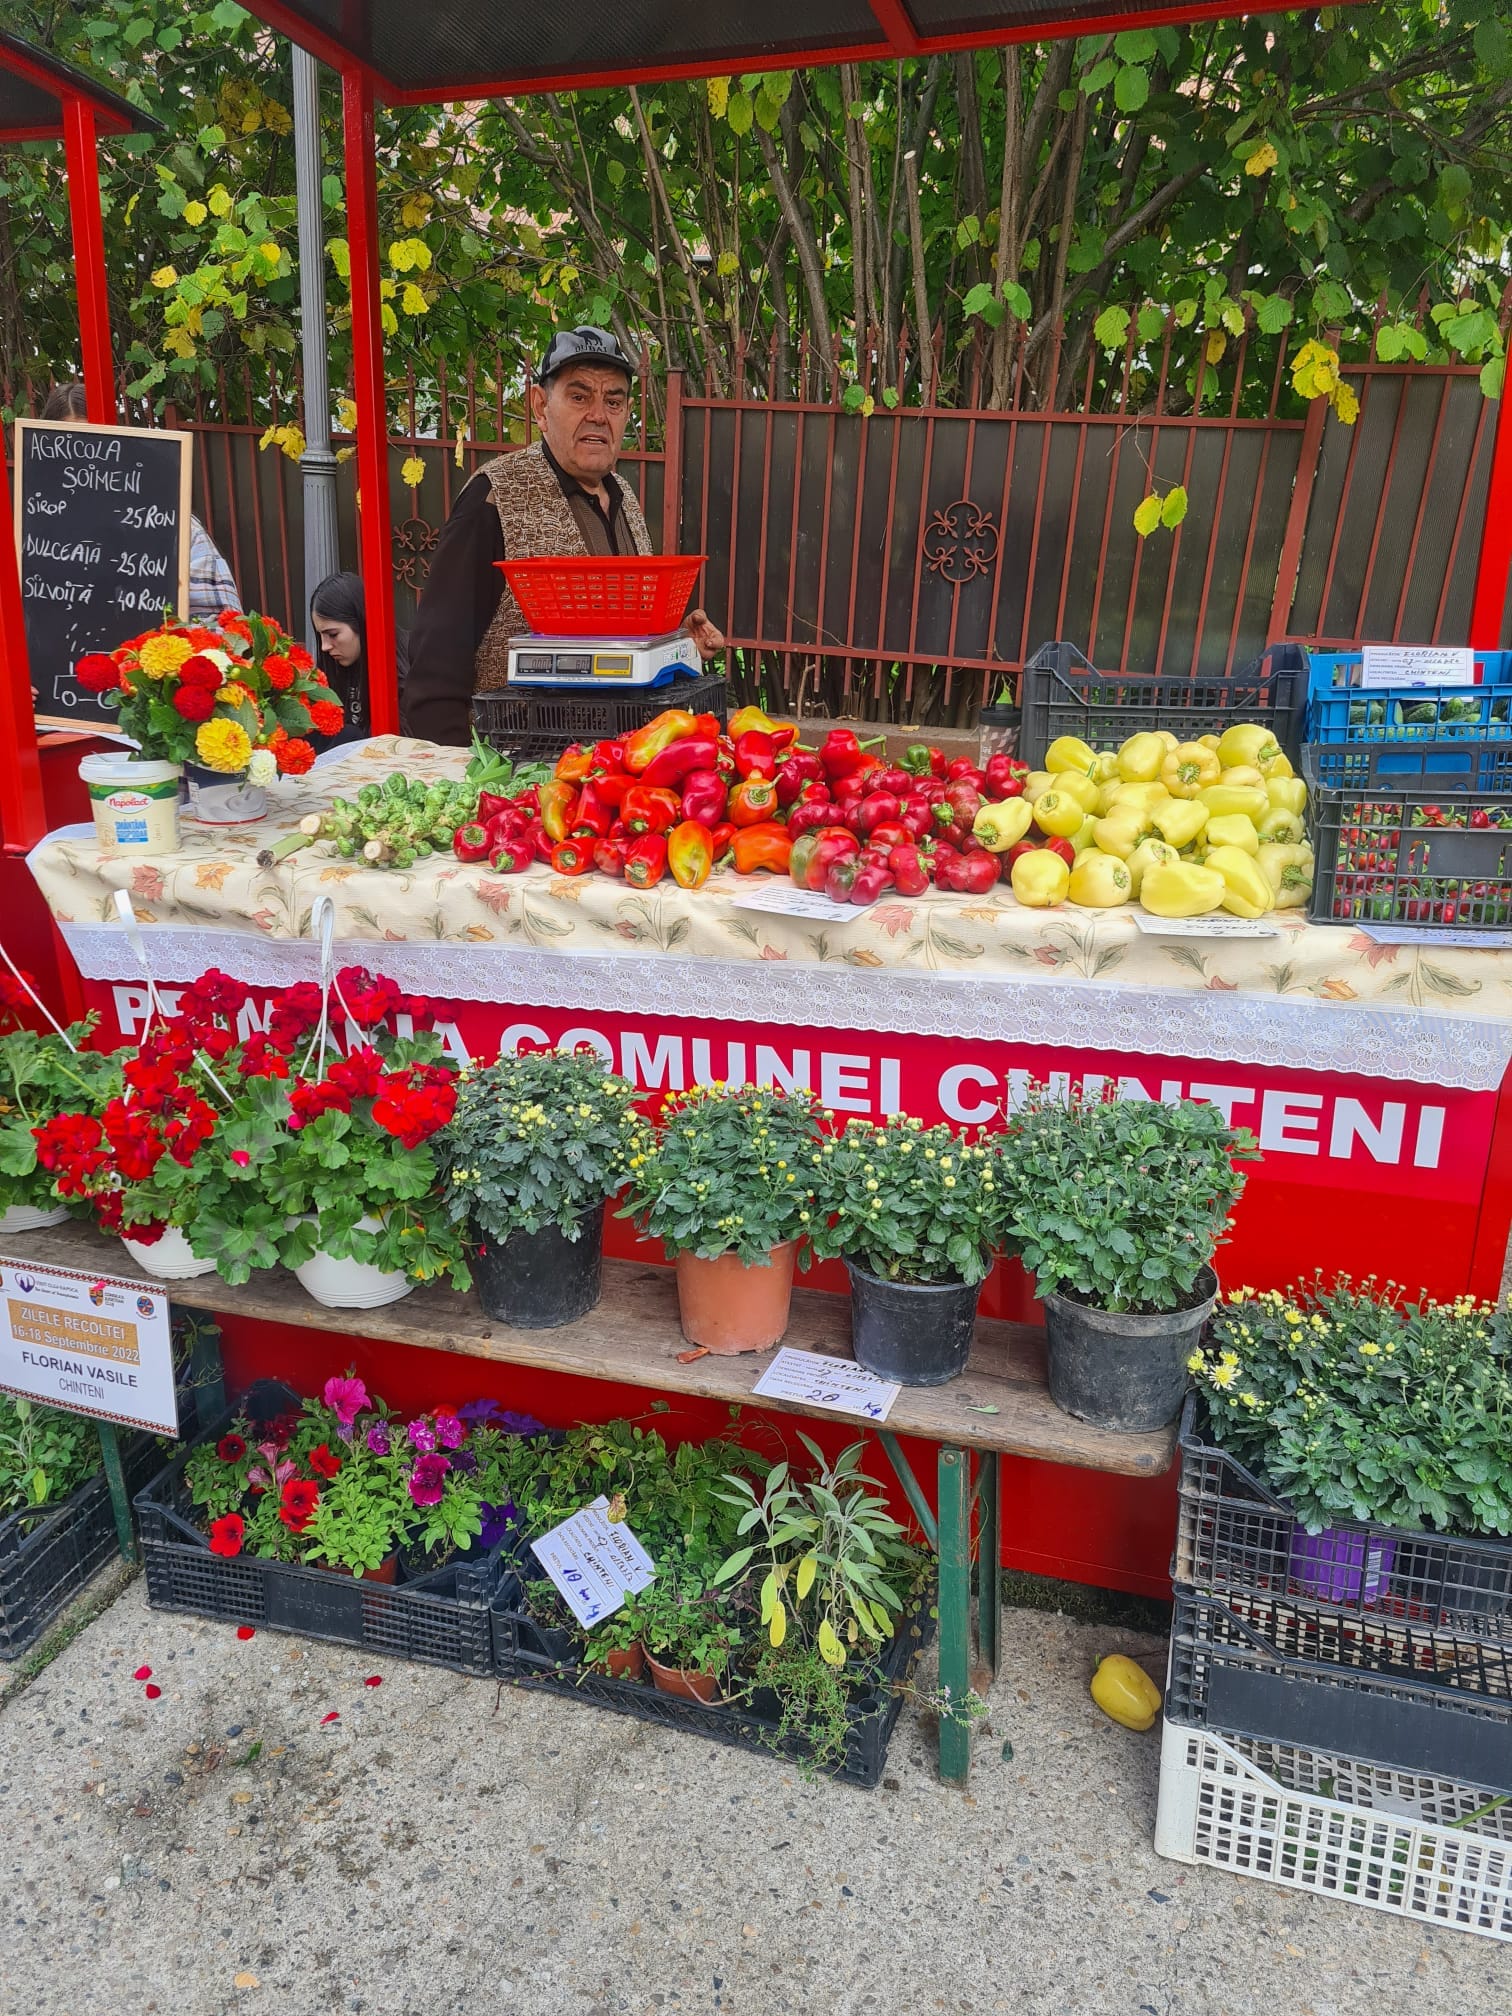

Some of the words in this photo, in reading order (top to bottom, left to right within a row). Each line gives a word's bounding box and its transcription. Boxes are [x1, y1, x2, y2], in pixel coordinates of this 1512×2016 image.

[31, 432, 121, 462] AGRICOLA
[27, 492, 67, 515] SIROP
[21, 1308, 61, 1327] ZILELE
[64, 1316, 125, 1340] RECOLTEI
[12, 1324, 42, 1342] 16-18
[44, 1330, 109, 1356] Septembrie
[112, 1346, 140, 1362] 2022
[22, 1351, 83, 1376] FLORIAN
[86, 1365, 139, 1388] VASILE
[58, 1378, 105, 1400] CHINTENI
[609, 1530, 635, 1563] FLORIAN
[562, 1568, 582, 1582] 10
[584, 1552, 615, 1588] CHINTENI
